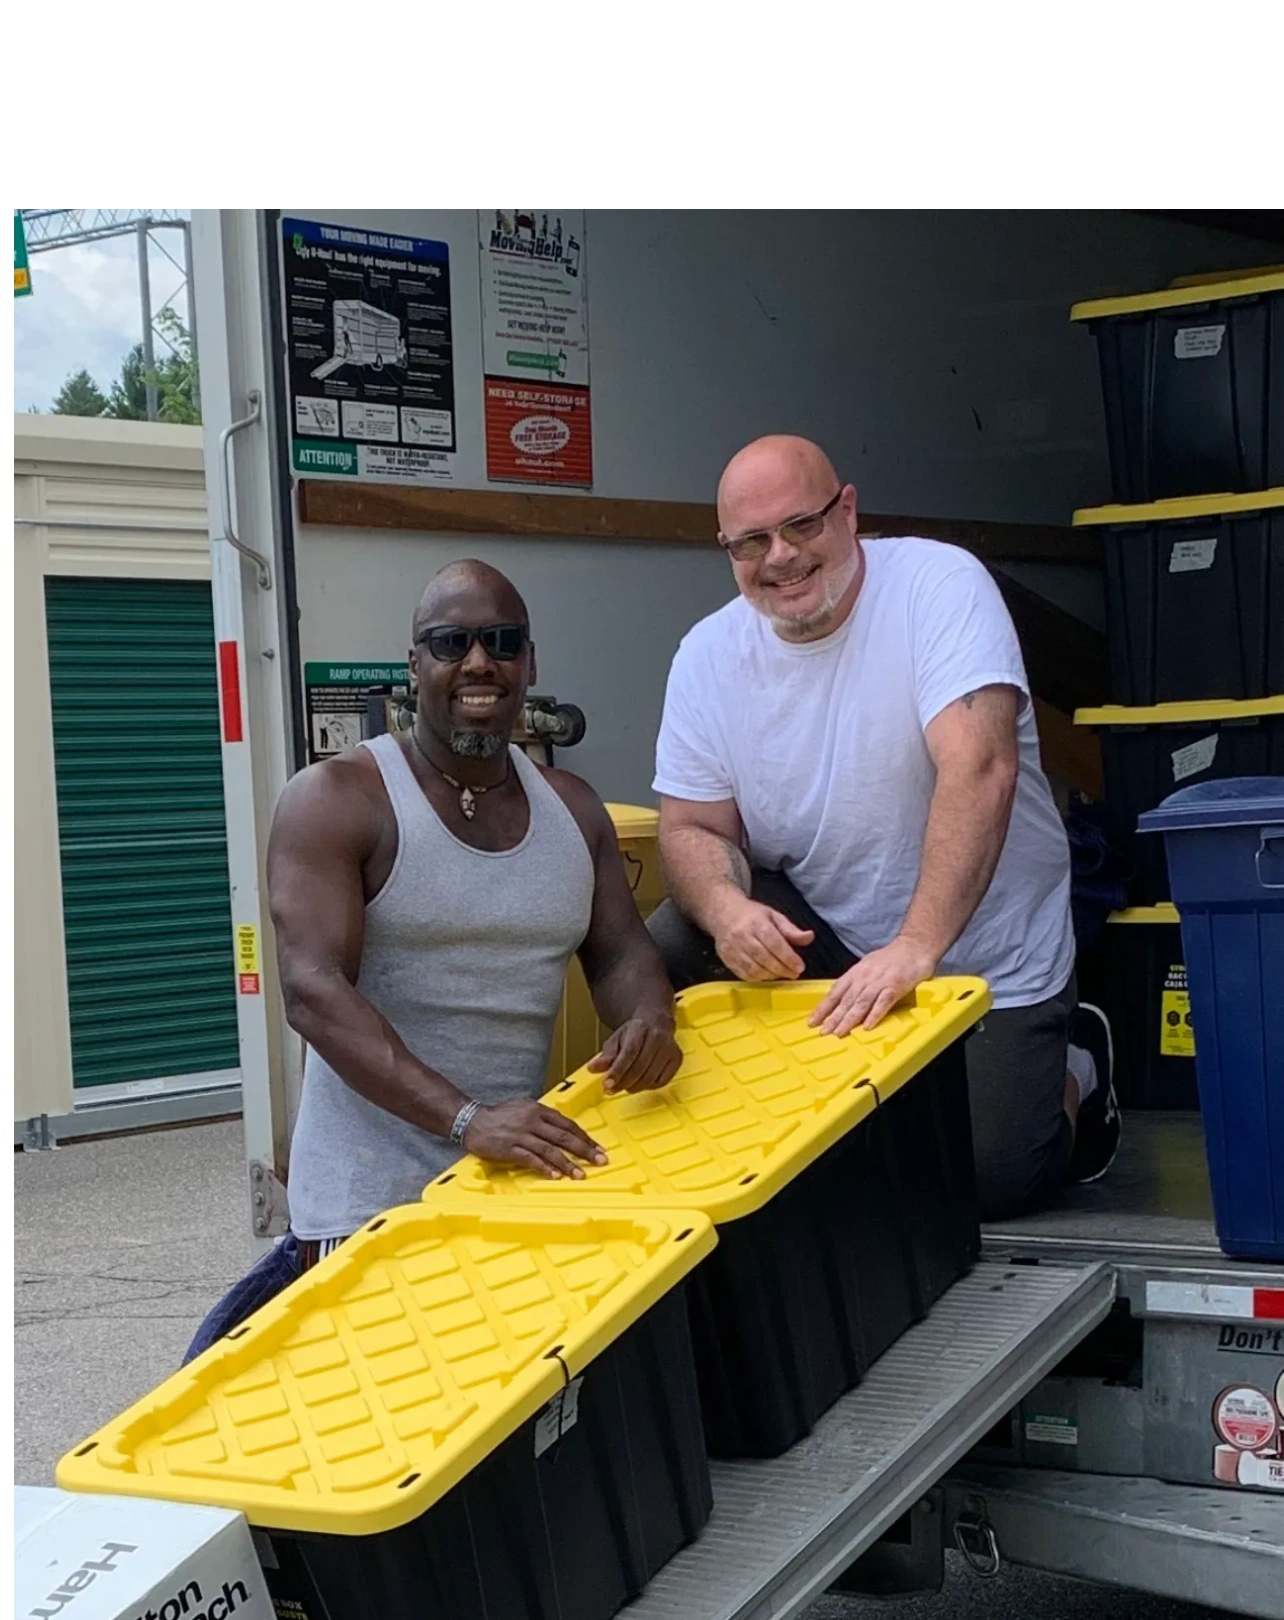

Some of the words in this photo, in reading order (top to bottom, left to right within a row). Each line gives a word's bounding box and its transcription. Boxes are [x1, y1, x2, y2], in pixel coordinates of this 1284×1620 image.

[488, 387, 515, 399] NEED
[329, 668, 351, 680] RAMP
[352, 668, 391, 680] OPERATING
[1218, 1324, 1282, 1351] Don't
